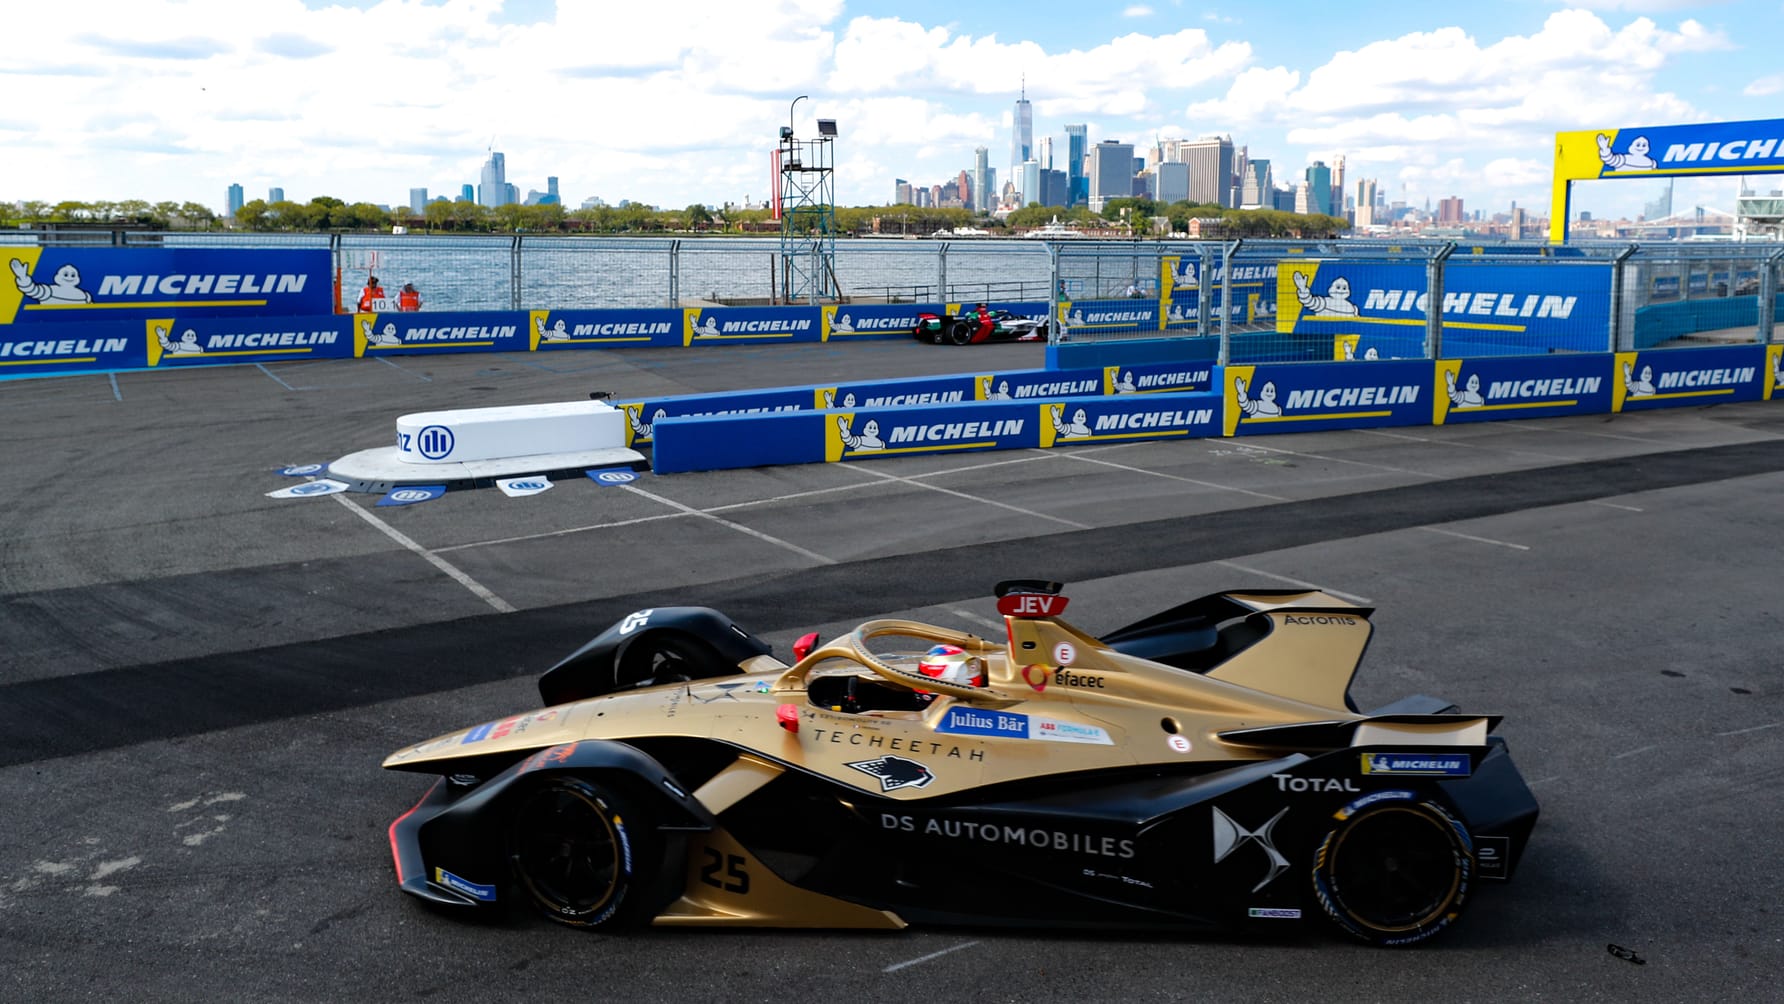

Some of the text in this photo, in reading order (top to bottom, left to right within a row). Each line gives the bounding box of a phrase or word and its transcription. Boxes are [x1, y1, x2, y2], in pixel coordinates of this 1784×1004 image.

[97, 273, 307, 295] MICHELIN
[722, 319, 811, 333] MICHELIN
[856, 316, 924, 329] MICHEL
[1086, 310, 1152, 322] MICHELIN
[404, 325, 517, 341] MICHELIN
[573, 321, 672, 337] MICHELIN
[0, 337, 128, 358] ICHELIN
[207, 330, 338, 349] MICHELIN
[1137, 370, 1209, 388] MICHELIN
[1658, 366, 1756, 389] MICHELIN
[1015, 379, 1098, 398] MICHELIN
[1285, 384, 1421, 410] MICHELIN
[1487, 376, 1602, 400] MICHELIN
[864, 390, 964, 407] MICHELIN
[1095, 408, 1213, 430] MICHELIN
[889, 418, 1025, 444] MICHELIN
[1012, 596, 1053, 614] JEV
[1284, 614, 1357, 626] Acronis
[1055, 669, 1105, 689] efacec
[950, 711, 1026, 732] Julius Bär
[814, 728, 985, 762] TECHEETAH
[1391, 759, 1461, 770] MICHELIN
[1271, 773, 1361, 793] TOTAL
[880, 813, 1136, 859] DS AUTOMOBILES
[702, 845, 750, 896] 25
